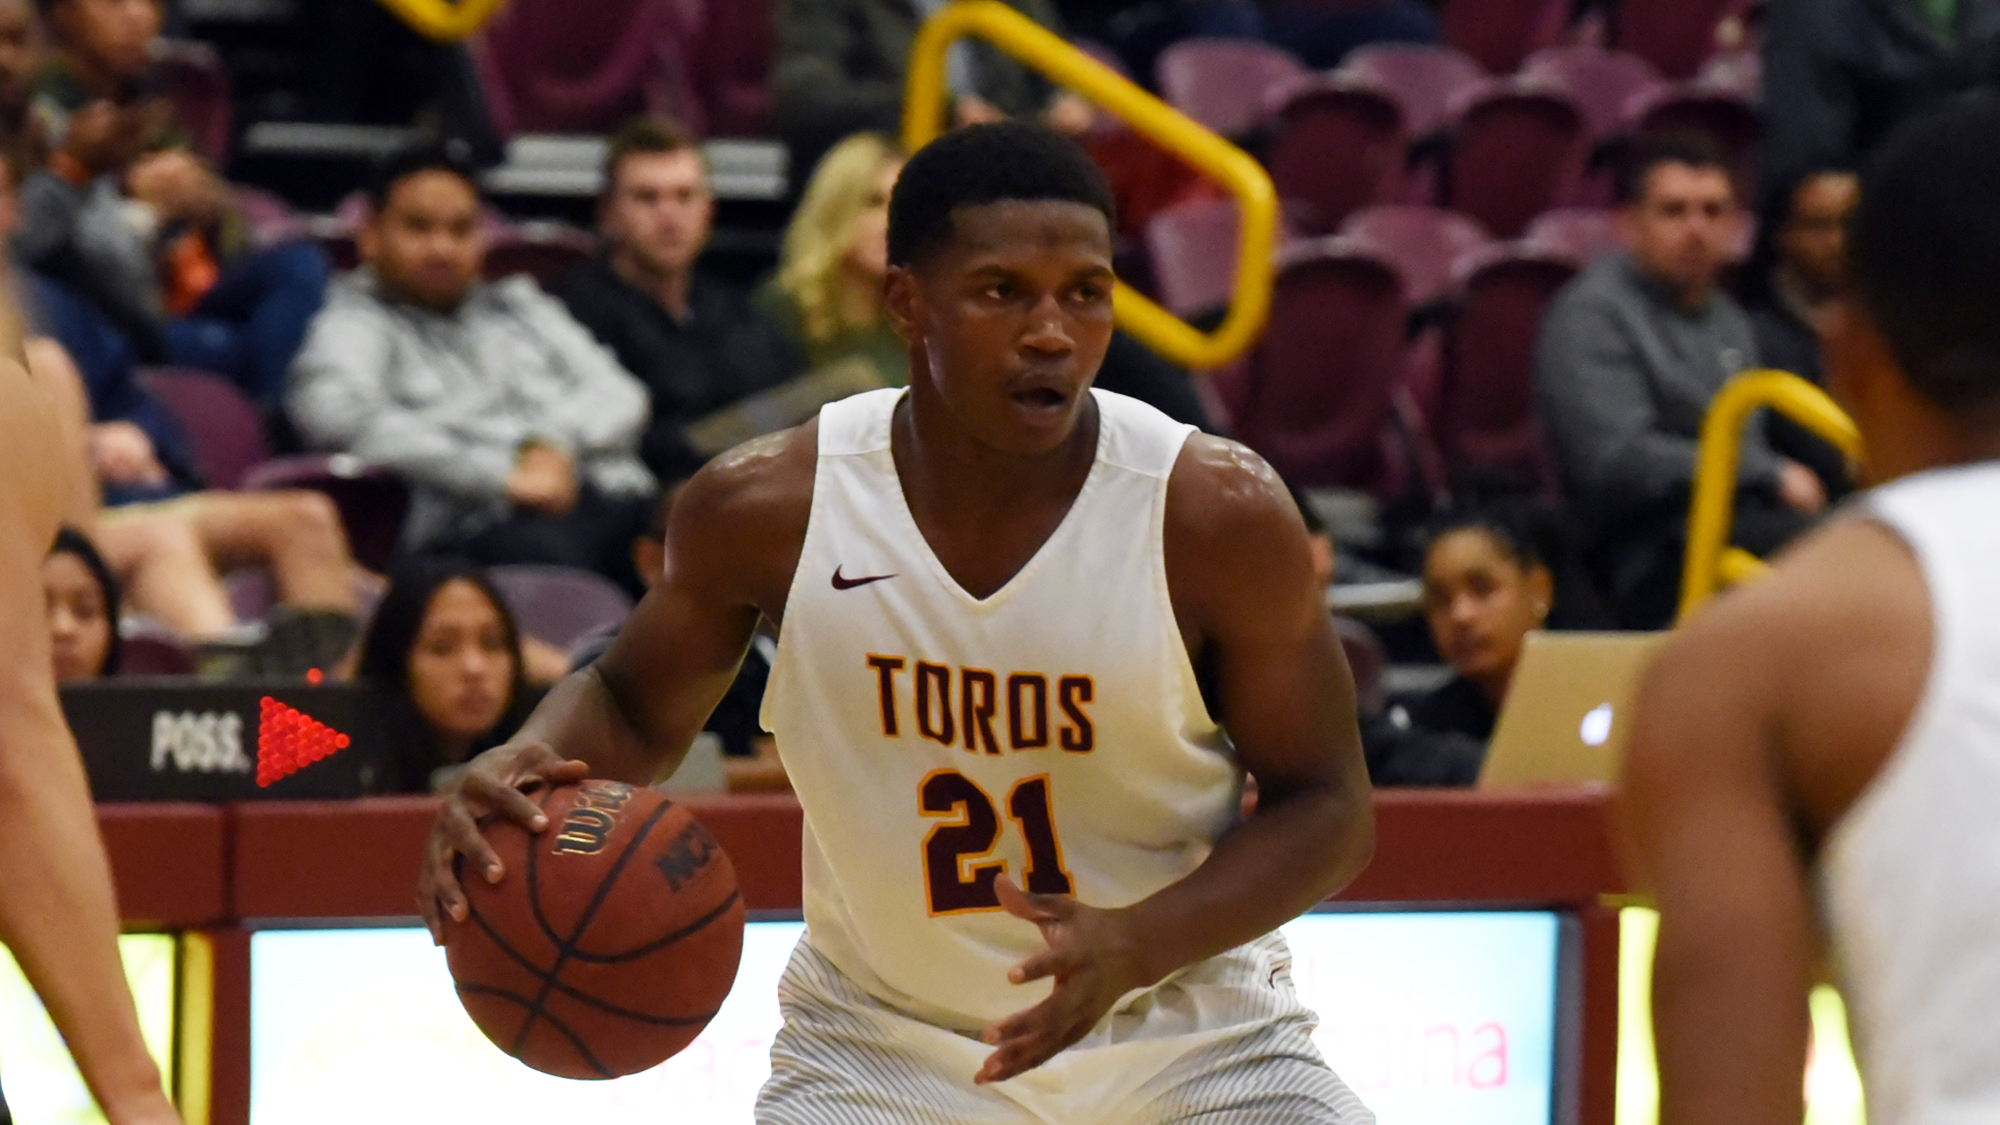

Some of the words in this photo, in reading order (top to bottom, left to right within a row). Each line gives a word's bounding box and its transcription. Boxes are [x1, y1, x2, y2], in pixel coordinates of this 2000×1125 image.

[151, 711, 251, 773] POSS.
[866, 652, 1096, 756] TOROS
[917, 768, 1077, 917] 21
